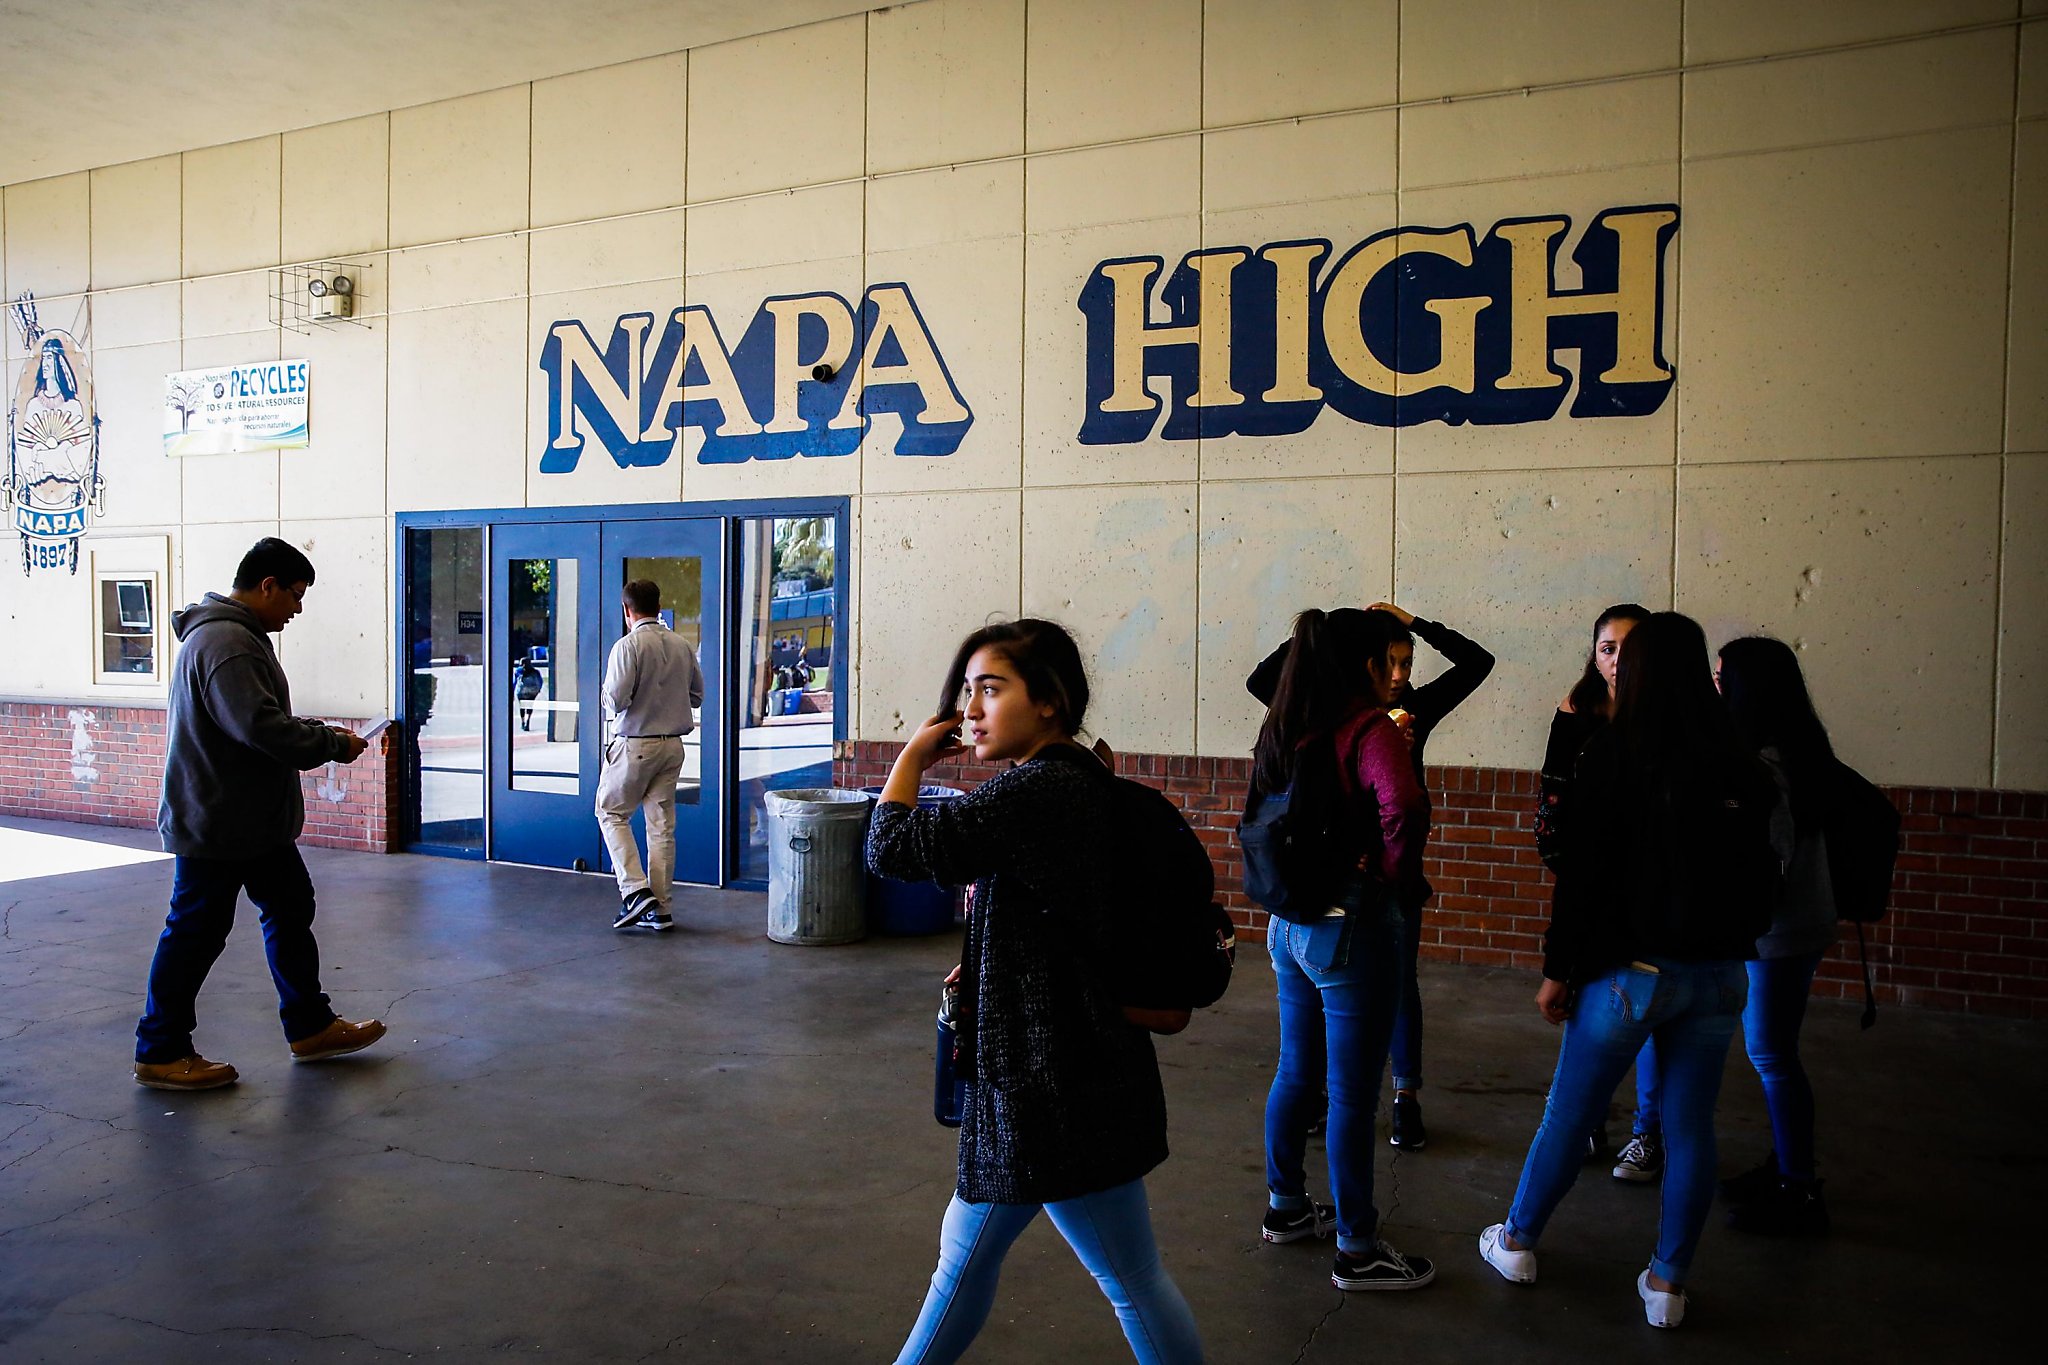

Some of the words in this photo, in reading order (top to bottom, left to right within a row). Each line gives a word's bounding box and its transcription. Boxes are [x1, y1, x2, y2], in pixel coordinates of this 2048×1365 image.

[540, 282, 975, 474] NAPA
[1077, 203, 1681, 445] HIGH
[231, 364, 305, 397] RECYCLES
[206, 403, 215, 412] TO
[216, 401, 233, 410] SVE
[234, 400, 265, 409] ATURAL
[266, 397, 305, 407] RESOURCES
[247, 414, 260, 422] para
[267, 421, 291, 429] naturales
[19, 509, 84, 534] NAPA
[33, 543, 67, 569] 1897
[461, 620, 475, 628] H34
